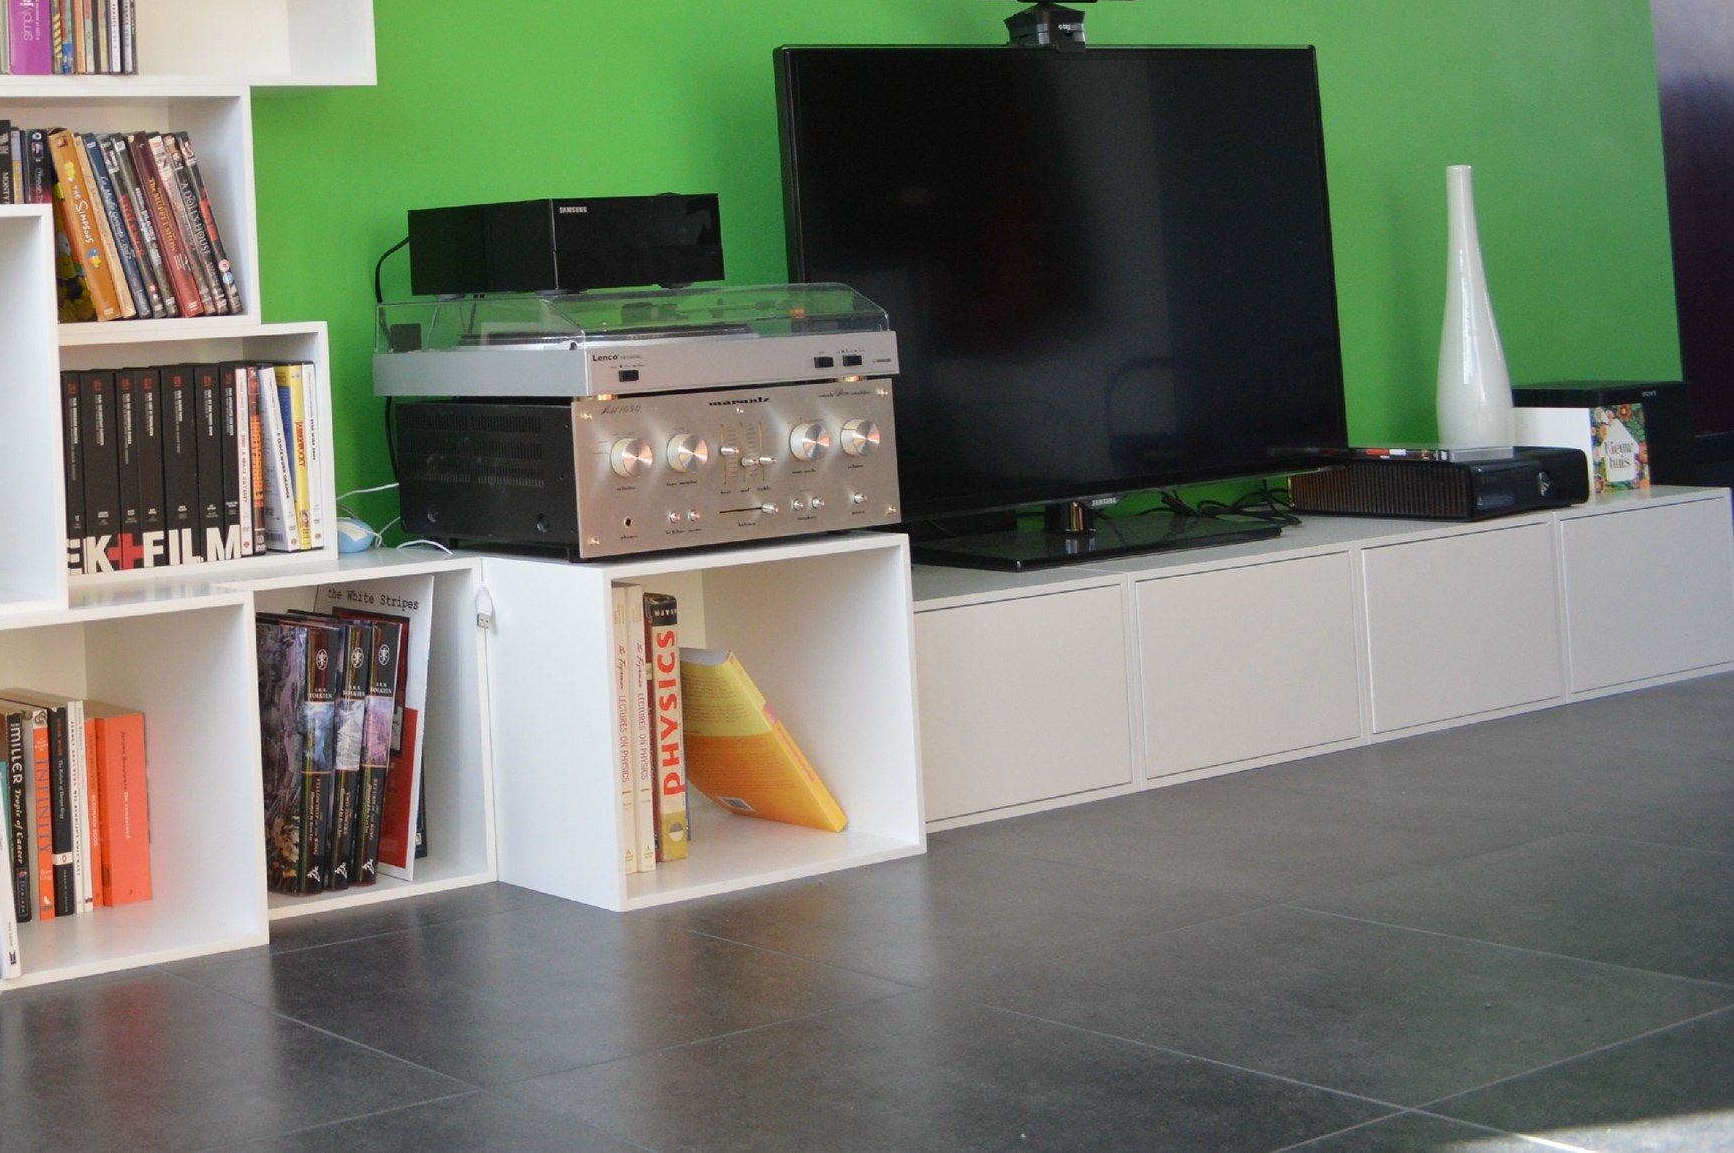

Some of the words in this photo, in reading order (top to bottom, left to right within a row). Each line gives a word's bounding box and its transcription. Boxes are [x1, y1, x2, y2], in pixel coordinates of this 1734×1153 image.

[2, 172, 10, 201] MONTY
[73, 185, 81, 199] THE
[75, 200, 94, 244] SIMPSONS
[559, 205, 587, 214] SAMSUNG
[592, 354, 619, 364] Lenco
[709, 398, 770, 407] marantz
[294, 421, 306, 468] JABBERWOCKY
[328, 588, 344, 602] the
[347, 589, 374, 606] White
[380, 594, 419, 611] Stripes
[618, 695, 628, 733] LECTURES
[637, 693, 647, 731] LECTURES
[656, 629, 686, 797] PHYSICS
[621, 750, 630, 783] PHYSICS
[641, 748, 649, 781] PHYSICS
[14, 789, 23, 818] Tropic
[37, 758, 52, 853] INFINITY
[15, 831, 25, 864] Cancer
